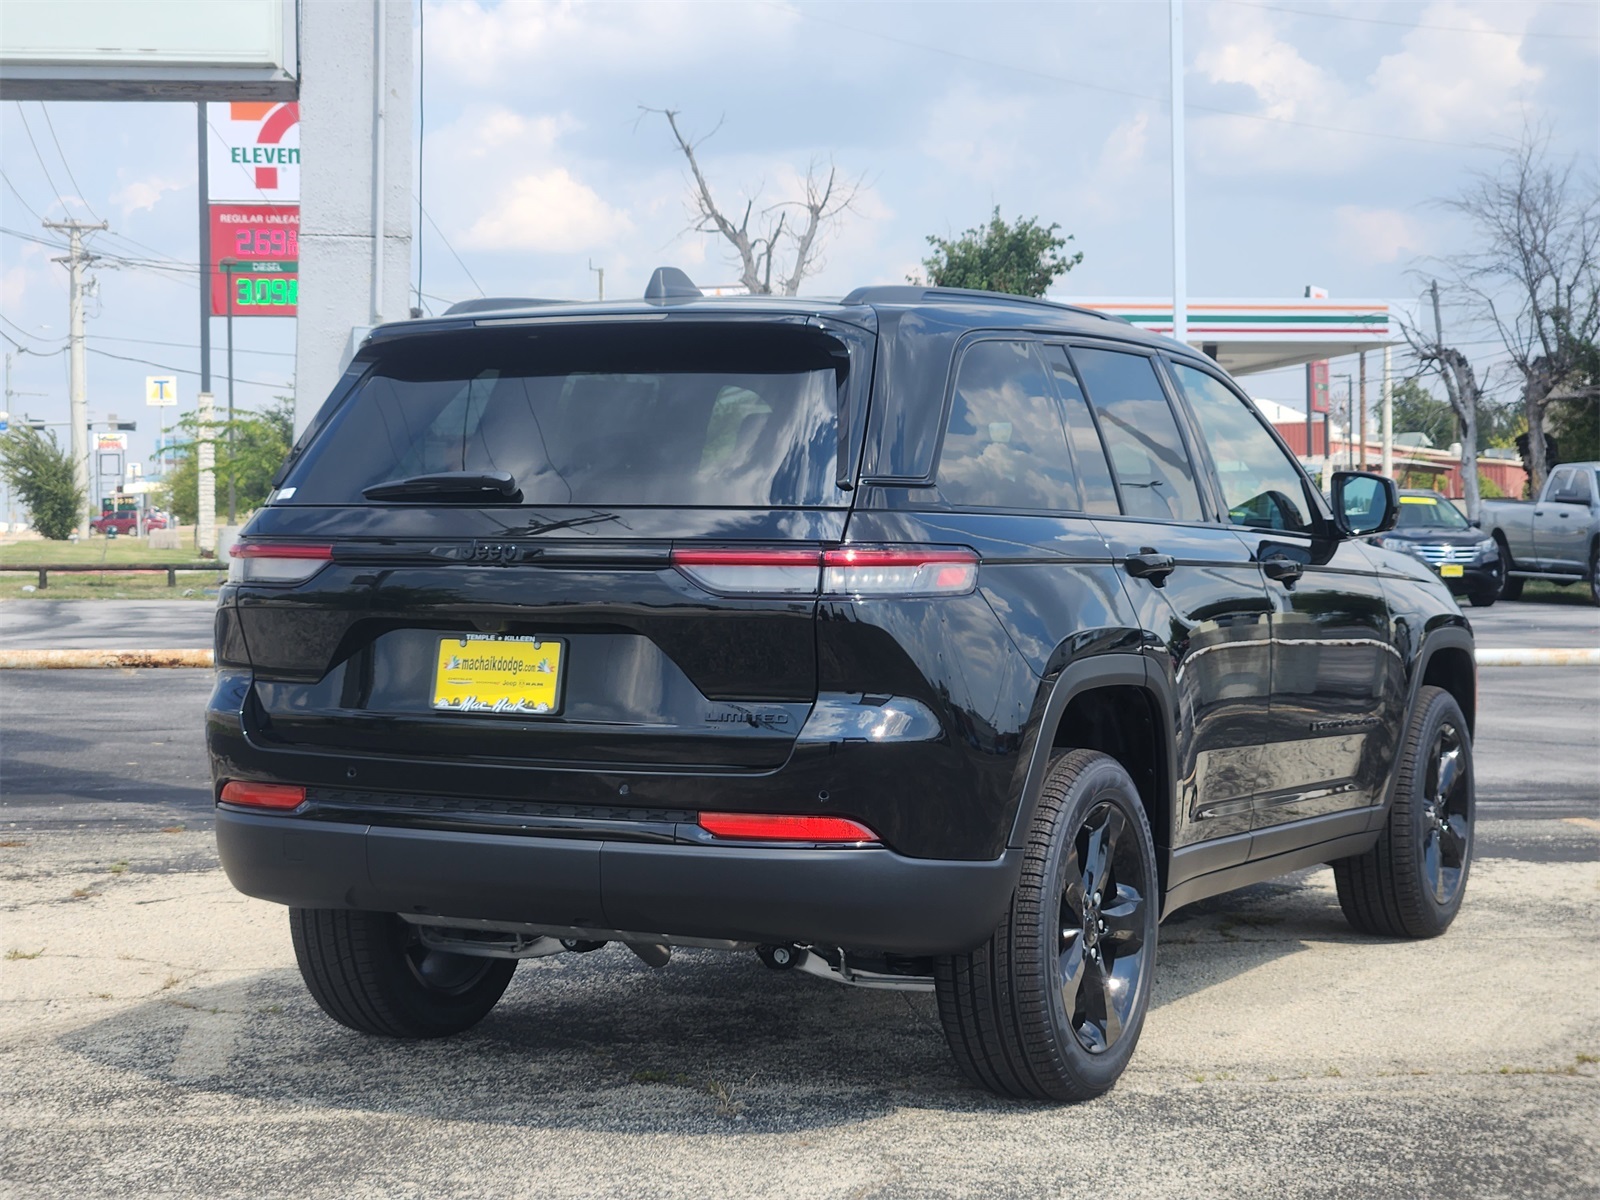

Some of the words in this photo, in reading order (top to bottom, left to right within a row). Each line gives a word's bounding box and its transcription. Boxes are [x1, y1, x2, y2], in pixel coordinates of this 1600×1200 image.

[219, 214, 264, 223] REGULAR
[252, 262, 283, 272] DIESEL
[462, 539, 516, 567] Jeep
[461, 656, 536, 675] machaikdodge.com
[459, 696, 489, 711] Mac
[492, 697, 528, 713] Haik
[705, 712, 788, 724] LIMITED
